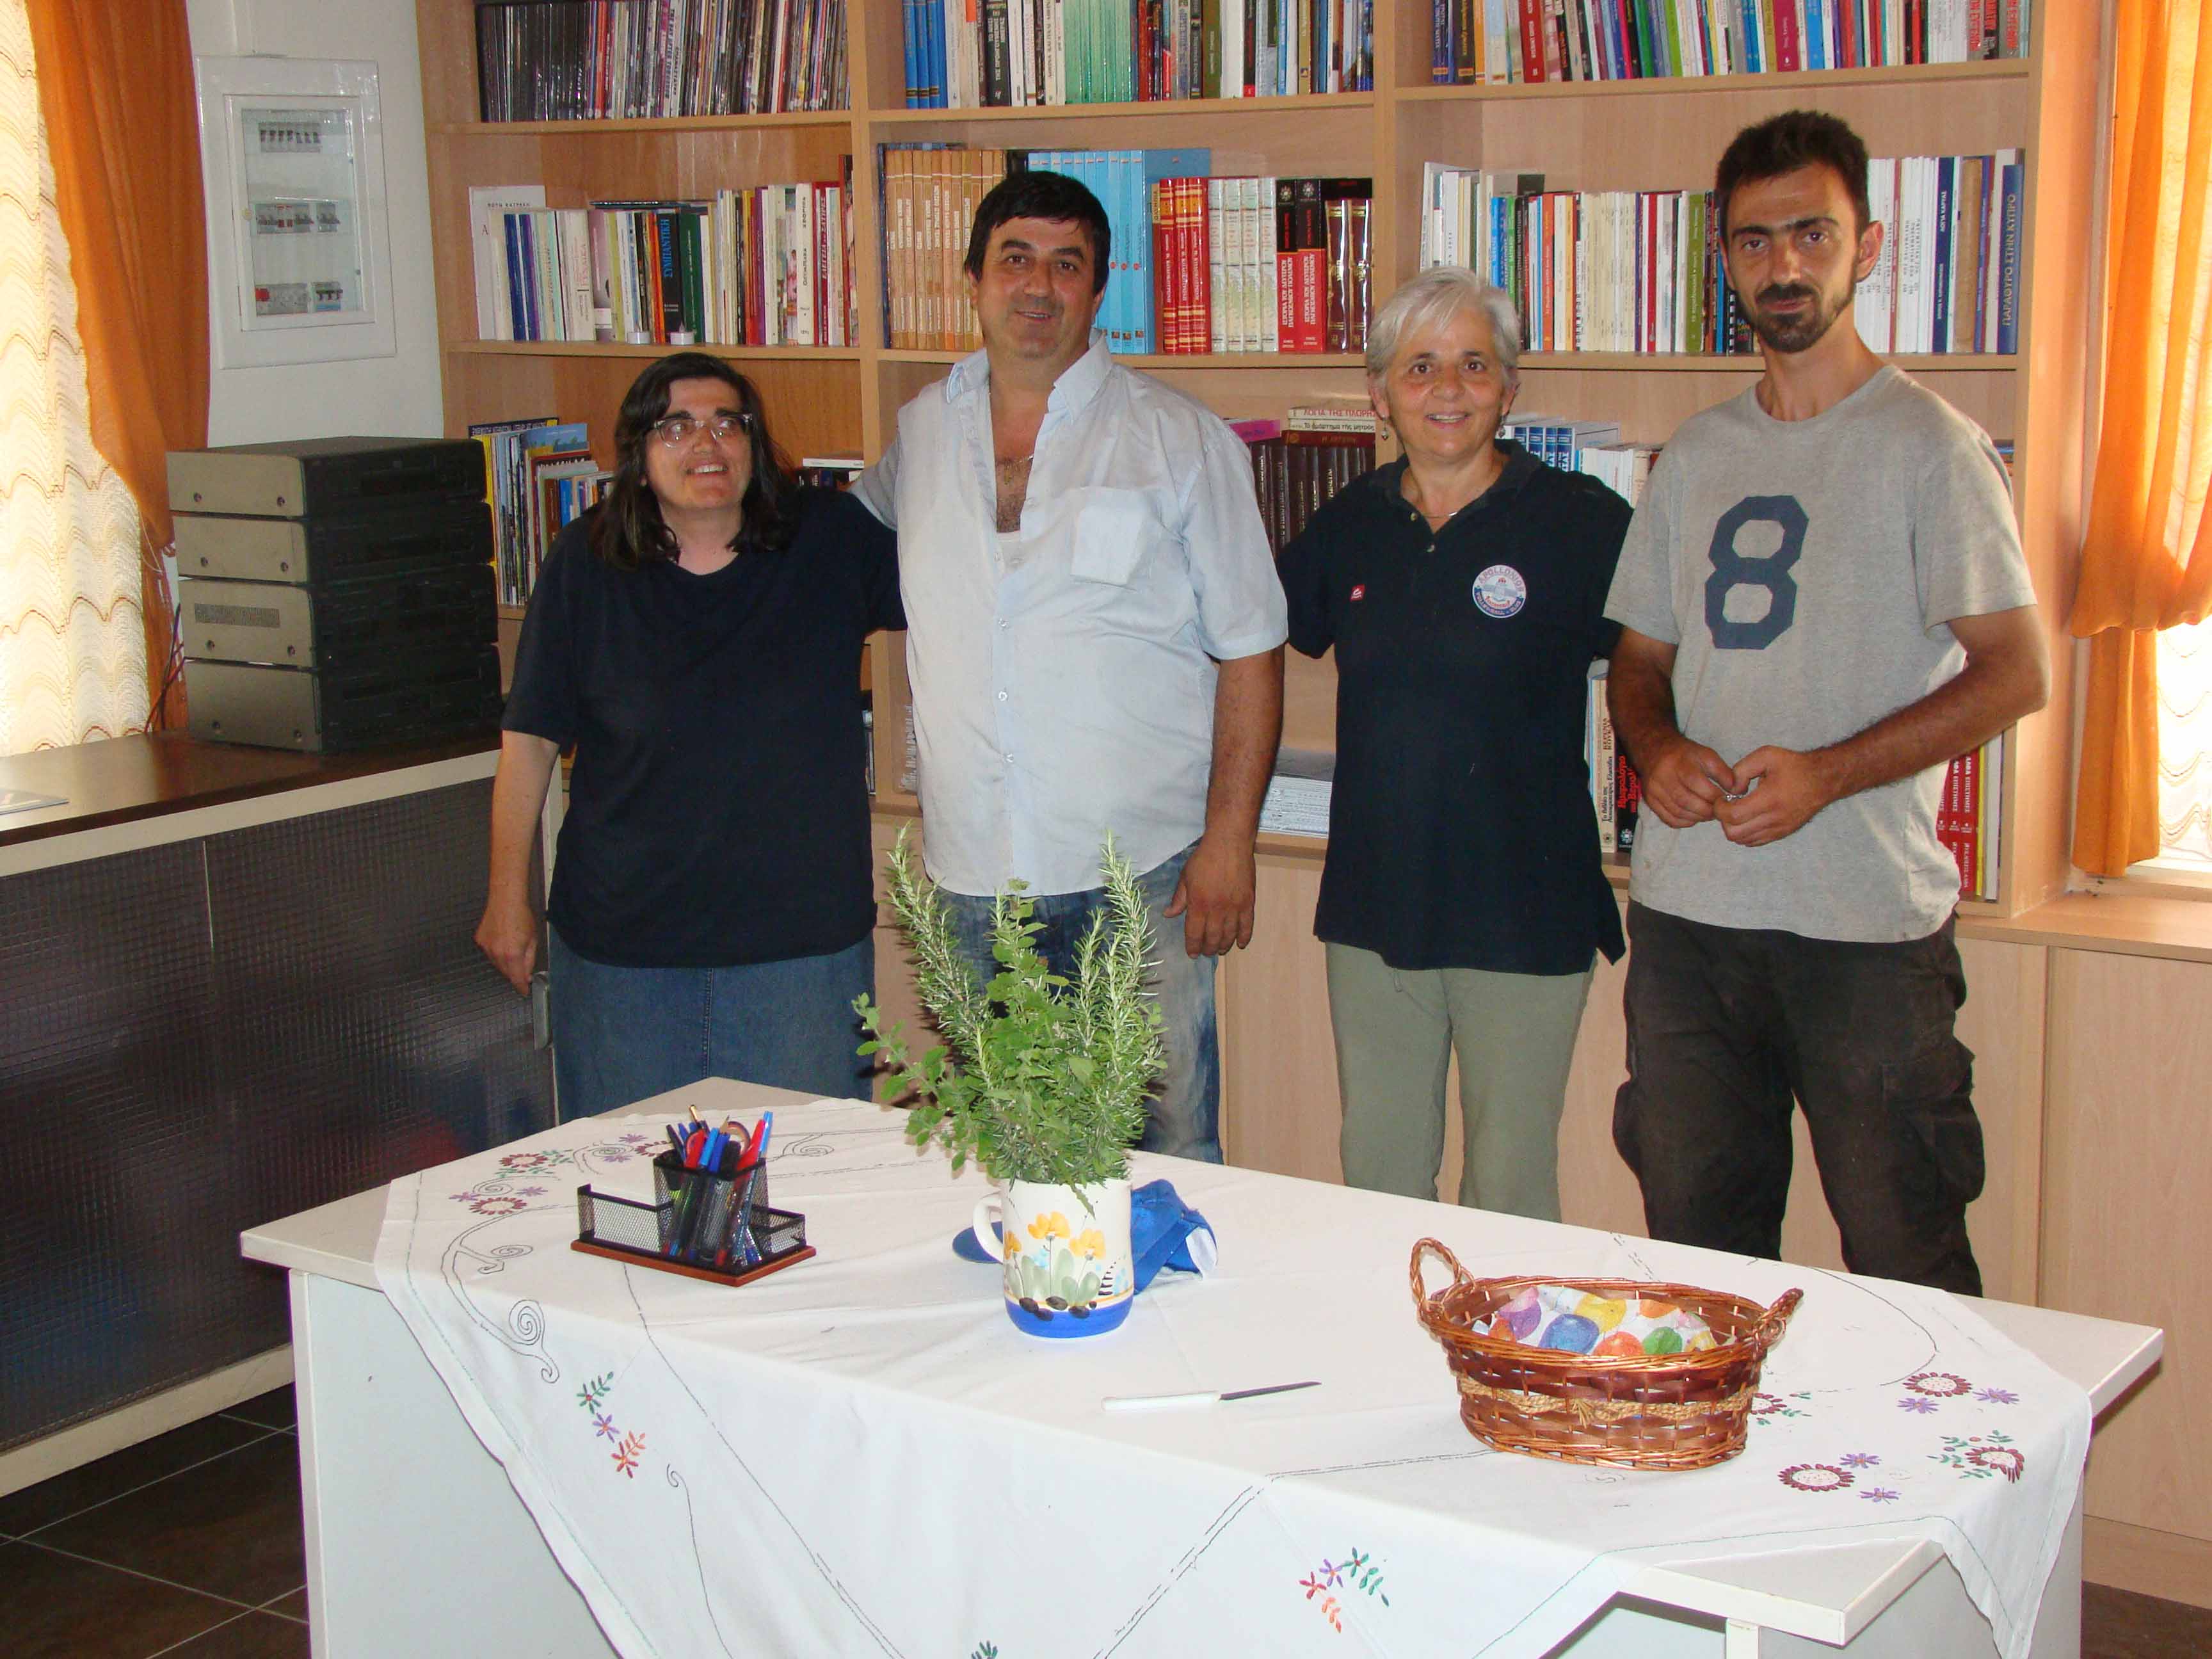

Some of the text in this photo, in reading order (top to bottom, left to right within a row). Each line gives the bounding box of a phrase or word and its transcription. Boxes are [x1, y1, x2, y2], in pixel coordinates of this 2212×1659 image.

[2001, 193, 2016, 326] ΠΑΡΑΘΥΡΟ ΣΤΗΝ ΚΥΠΡΟ
[1705, 495, 1809, 650] 8
